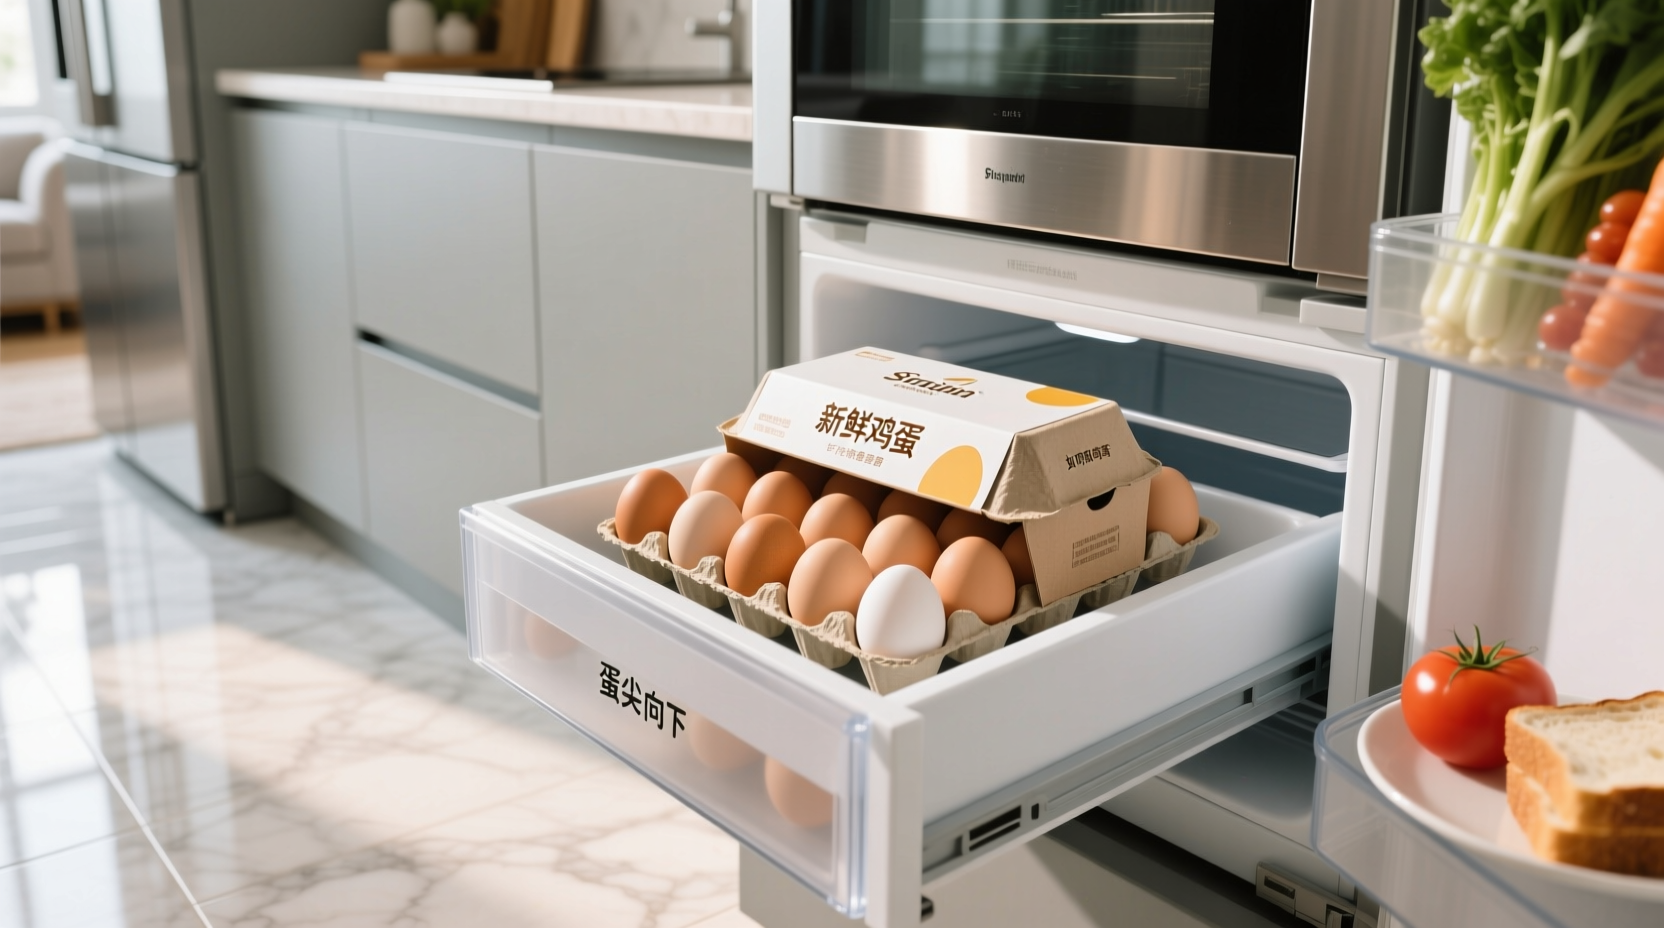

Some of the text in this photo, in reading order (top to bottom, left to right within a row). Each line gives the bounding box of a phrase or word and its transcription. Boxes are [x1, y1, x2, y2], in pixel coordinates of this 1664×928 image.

[815, 402, 926, 459] 新鲜鸡蛋
[599, 660, 687, 739] 蛋尖向下
